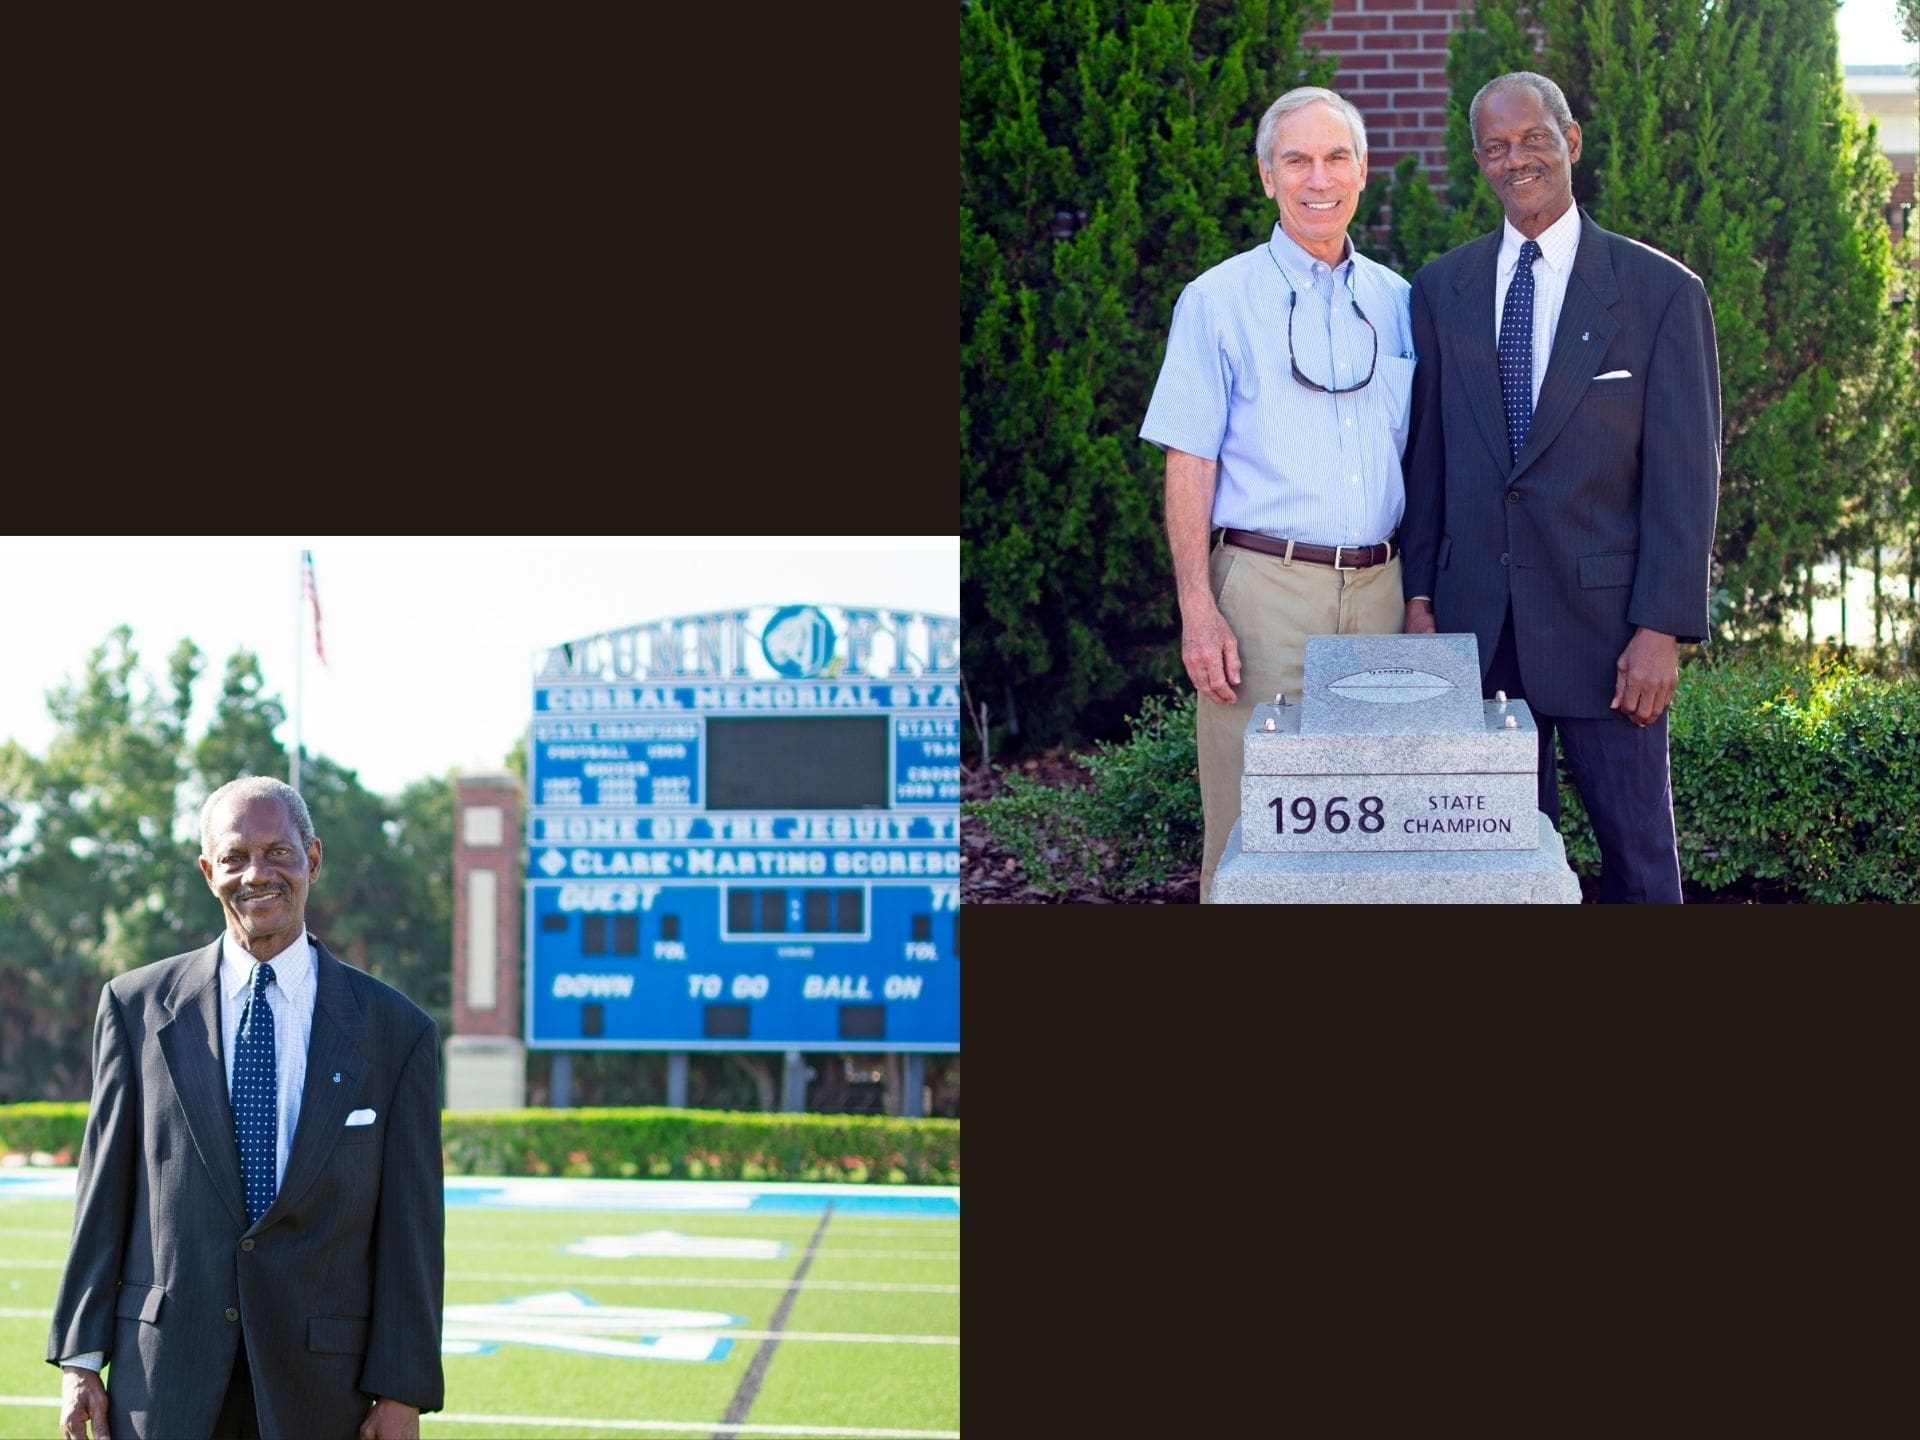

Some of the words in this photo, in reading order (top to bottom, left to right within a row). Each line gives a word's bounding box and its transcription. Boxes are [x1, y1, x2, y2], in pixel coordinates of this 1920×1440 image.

[537, 610, 750, 678] ALUMNI
[545, 686, 684, 710] CORRAL
[693, 686, 880, 709] MEMORIAL
[1267, 795, 1386, 835] 1968
[1428, 795, 1486, 811] STATE
[543, 816, 639, 840] HOME
[651, 816, 694, 840] OF
[707, 816, 776, 840] THE
[787, 816, 914, 840] JESUIT
[1403, 818, 1512, 834] CHAMPION
[571, 849, 671, 875] CLARK
[687, 849, 826, 875] MARTINO
[557, 883, 662, 912] GUEST
[552, 974, 635, 998] DOWN
[688, 974, 722, 998] TO
[731, 974, 770, 998] GO
[803, 974, 873, 998] BALL
[884, 974, 922, 998] ON
